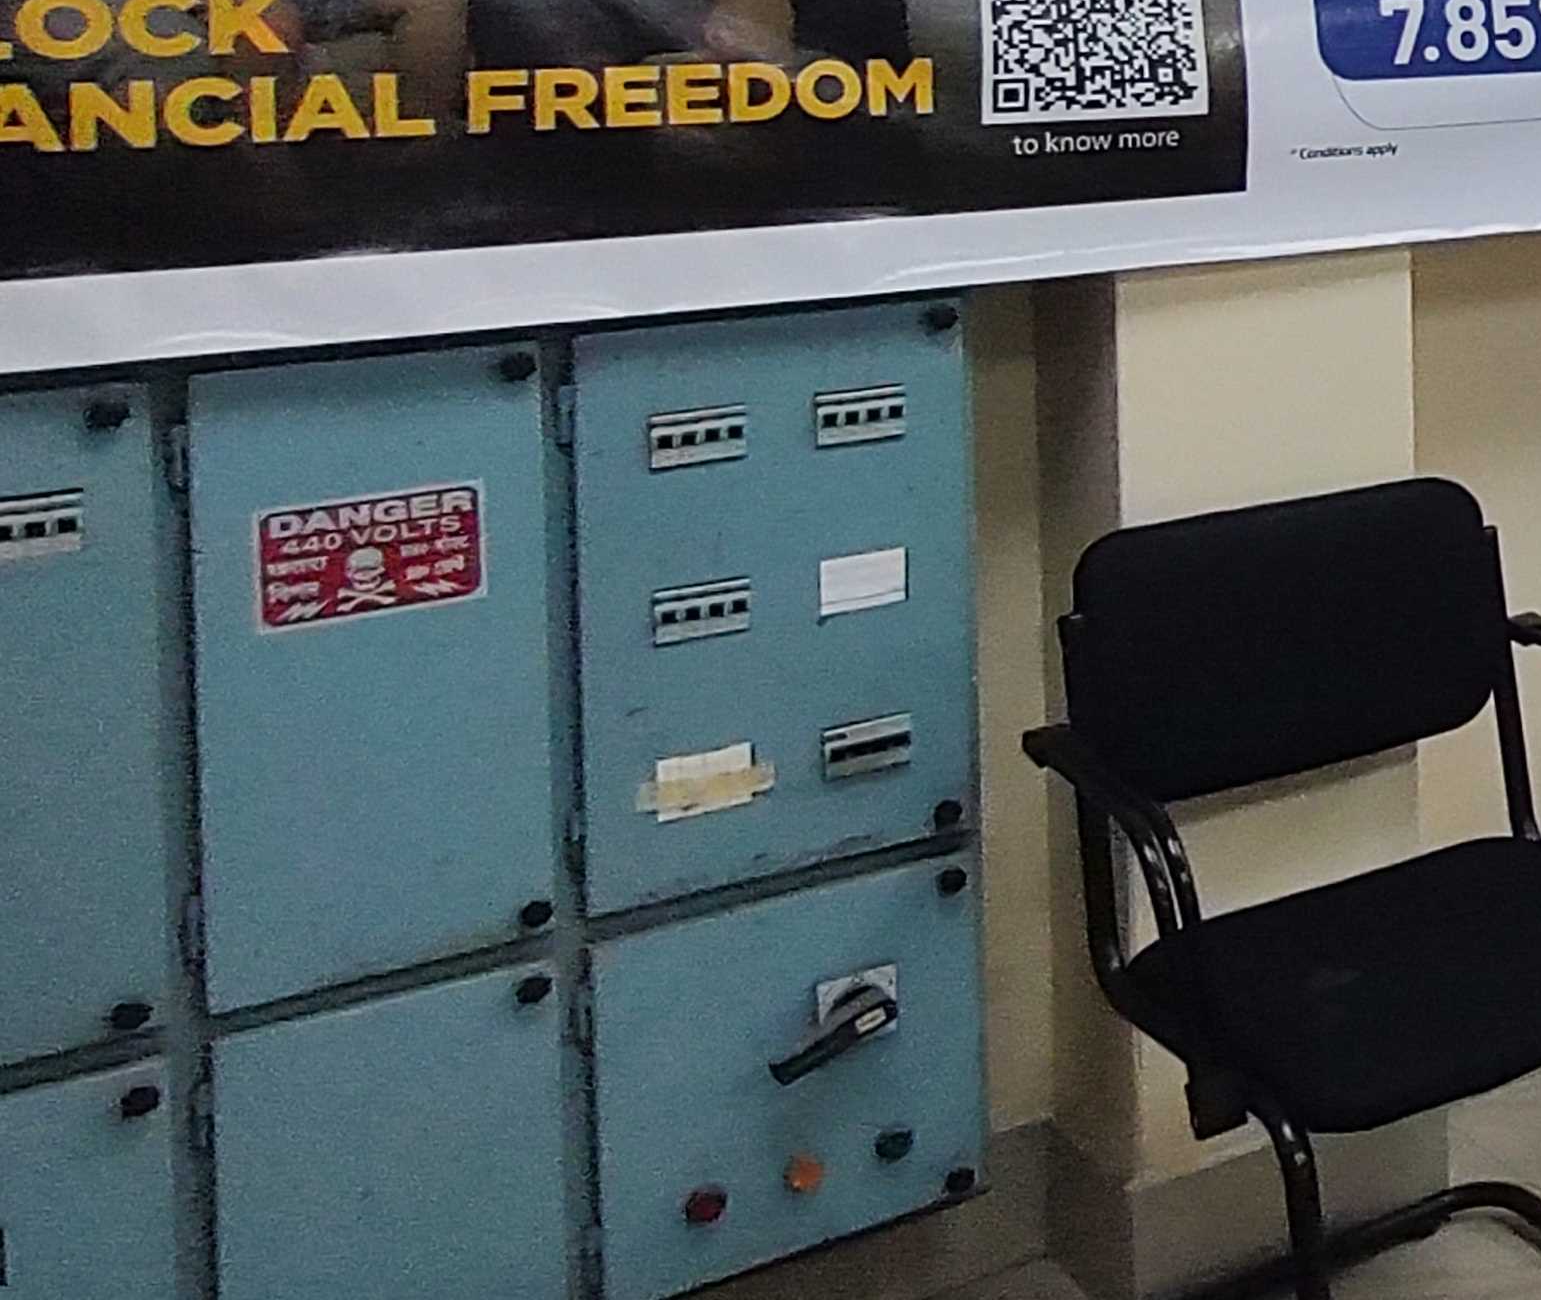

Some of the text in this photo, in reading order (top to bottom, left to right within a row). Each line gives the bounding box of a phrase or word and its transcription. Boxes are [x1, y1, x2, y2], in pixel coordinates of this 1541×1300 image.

[467, 58, 933, 134] FREEDOM
[1013, 129, 1180, 155] to know more
[1366, 142, 1398, 159] apply
[269, 490, 474, 539] DANGER
[281, 533, 342, 554] 440
[350, 515, 462, 546] VOLTS
